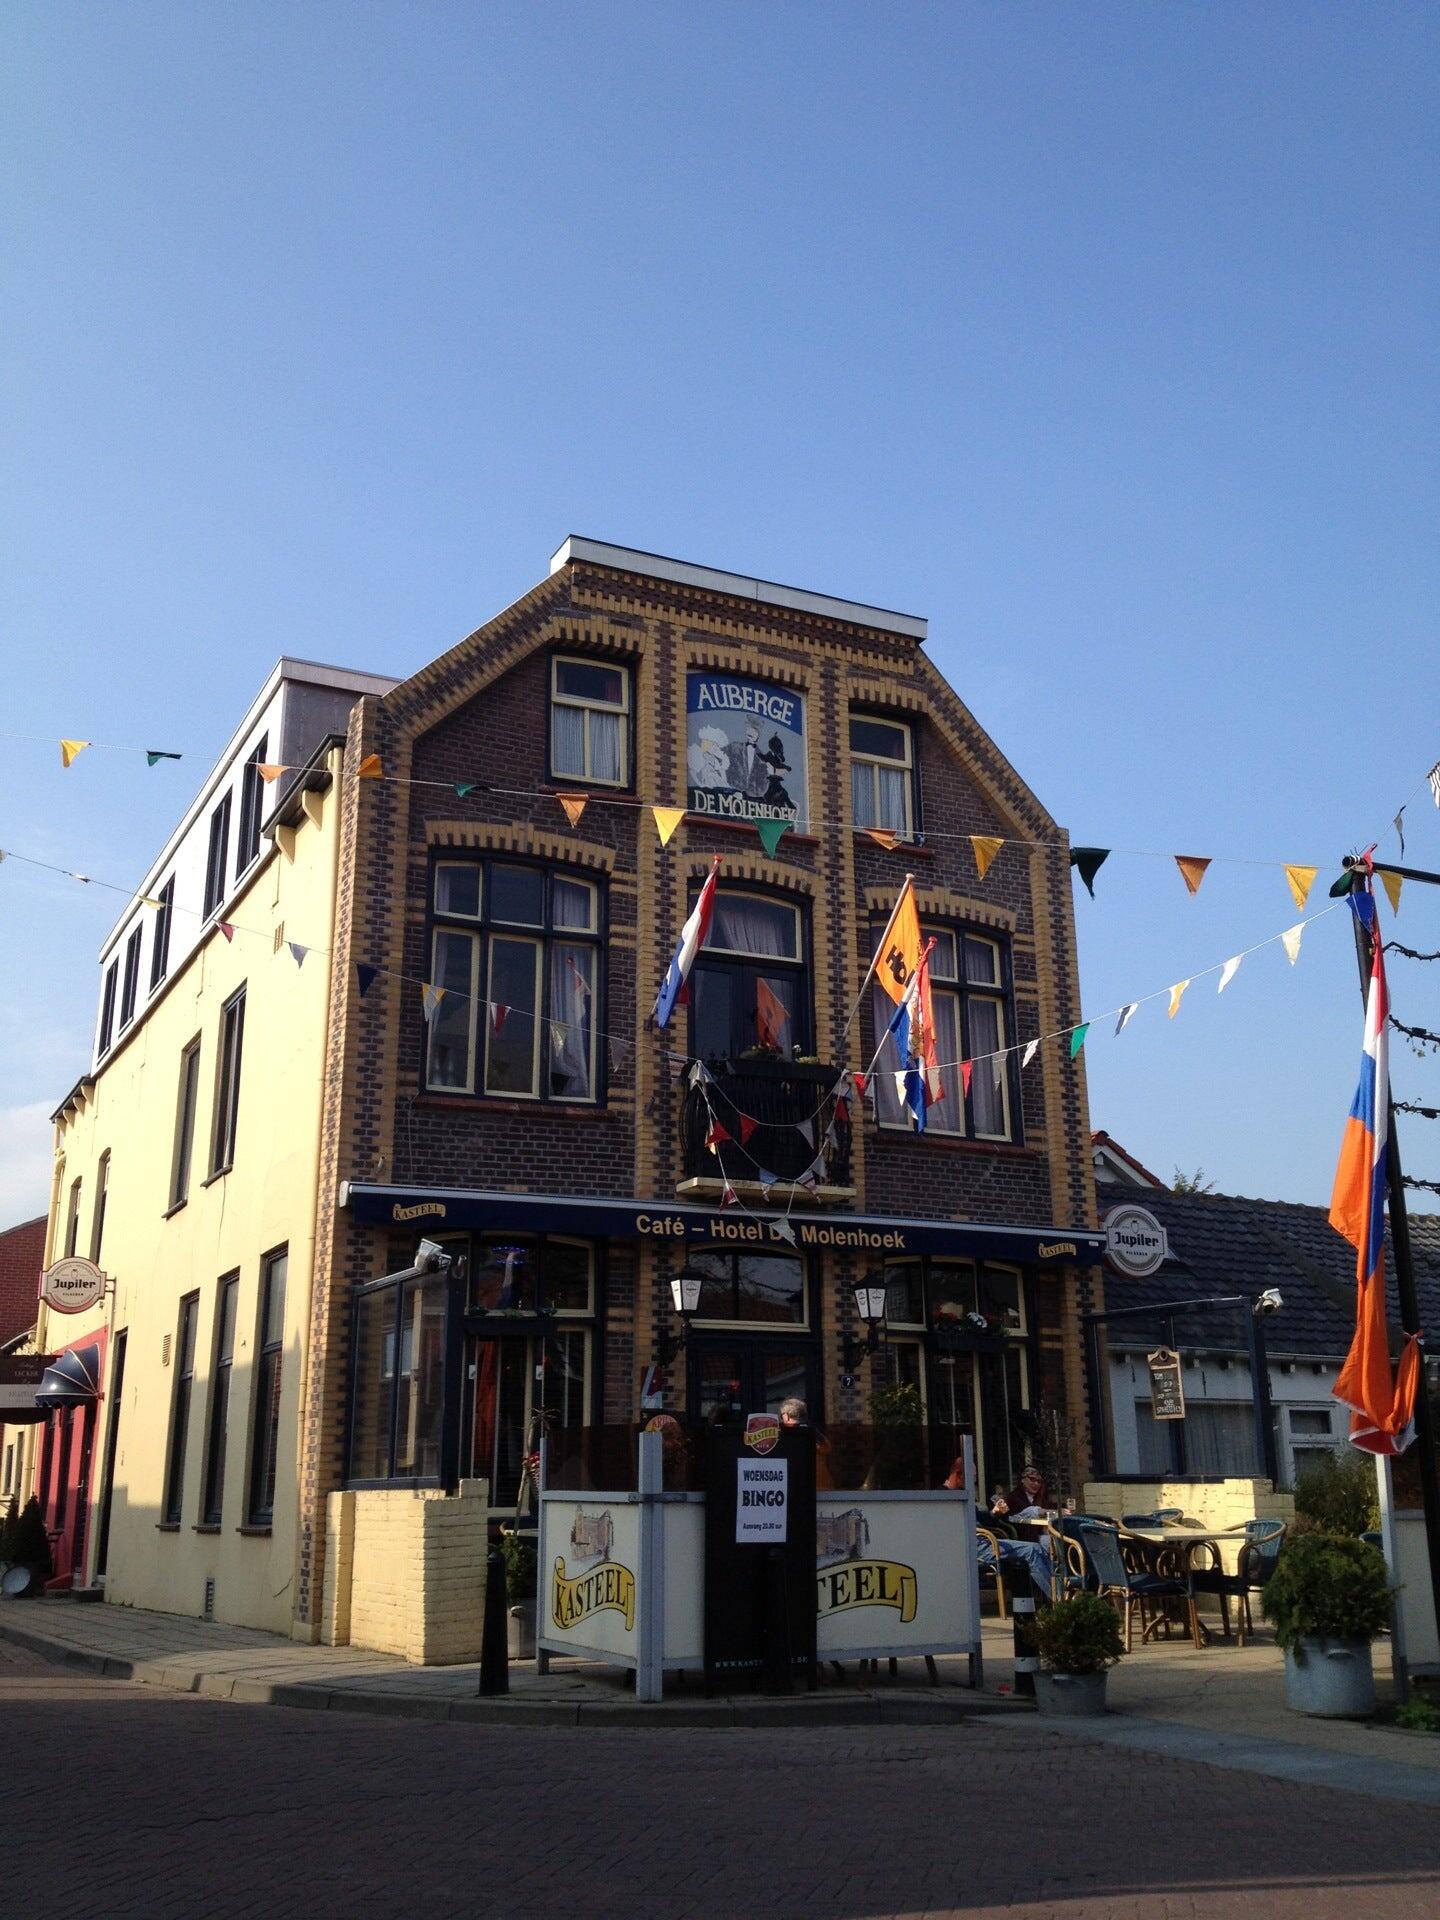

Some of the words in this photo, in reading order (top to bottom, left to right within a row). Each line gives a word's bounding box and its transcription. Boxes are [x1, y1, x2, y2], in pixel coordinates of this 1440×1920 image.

[697, 684, 794, 725] AUBERGE
[694, 790, 716, 814] DE
[395, 1204, 440, 1220] KASTEEL
[636, 1214, 685, 1236] Café
[710, 1220, 763, 1241] Hotel
[801, 1225, 905, 1249] Molenhoek
[1115, 1231, 1159, 1248] Jupiler
[53, 1279, 96, 1290] Jupiler
[743, 1470, 784, 1482] WOENSDAG
[742, 1490, 785, 1507] BINGO
[555, 1569, 625, 1627] KASTEEL
[816, 1566, 898, 1613] TEEL
